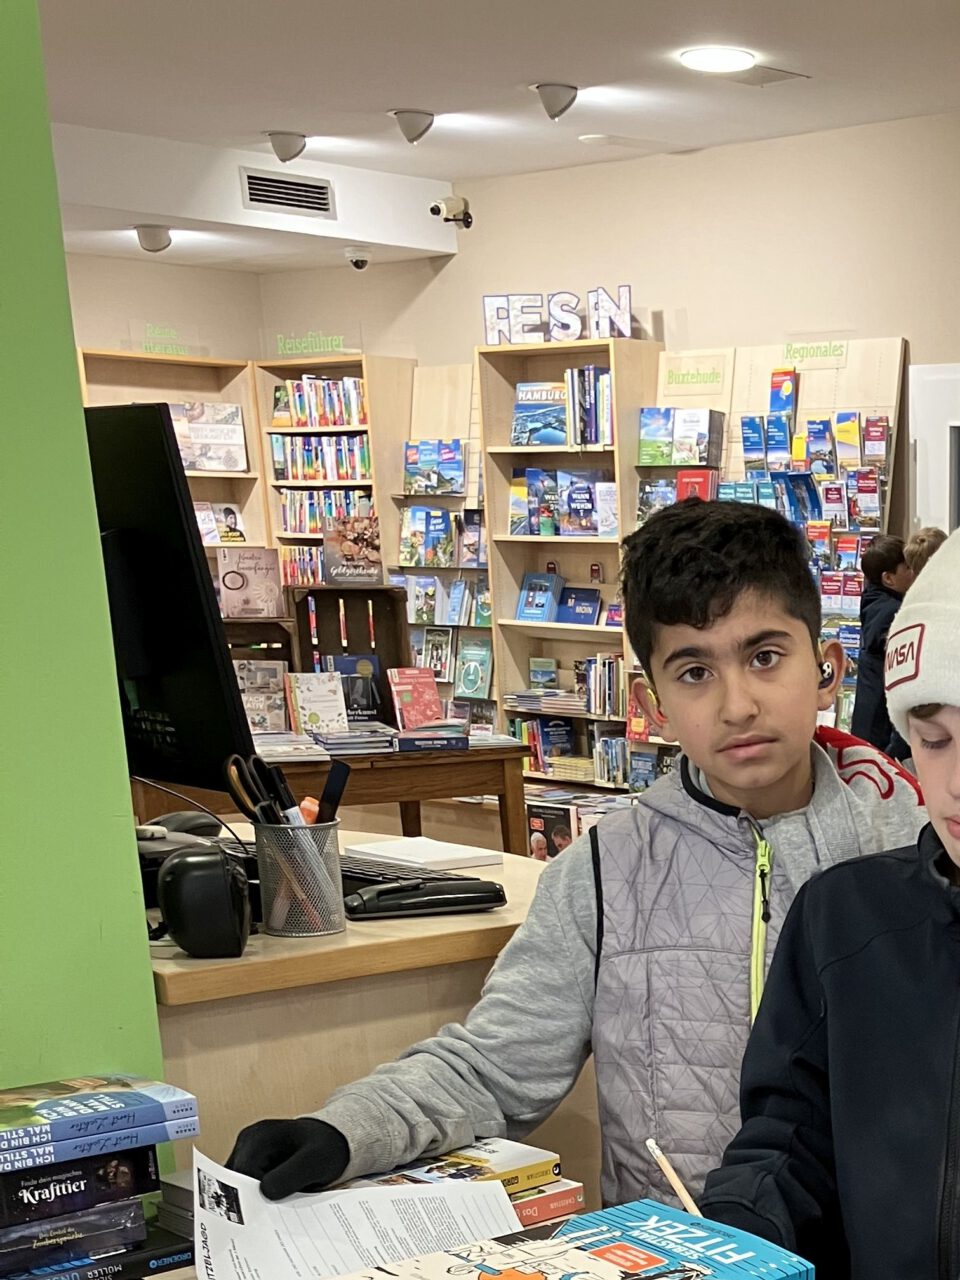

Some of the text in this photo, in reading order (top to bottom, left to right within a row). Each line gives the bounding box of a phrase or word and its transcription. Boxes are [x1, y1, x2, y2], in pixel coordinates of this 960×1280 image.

[785, 341, 844, 363] Regionales
[667, 366, 721, 386] Buxtehude
[886, 641, 915, 673] NASA
[27, 1124, 50, 1135] MAL
[10, 1133, 51, 1146] ICH BIN
[32, 1146, 54, 1156] MAL
[15, 1154, 55, 1168] ICH BIN
[18, 1177, 88, 1204] Krafttier
[522, 1207, 538, 1217] Das
[626, 1215, 756, 1265] FITZEK
[628, 1230, 704, 1260] SEBASTIAN
[157, 1252, 192, 1265] DROEMER
